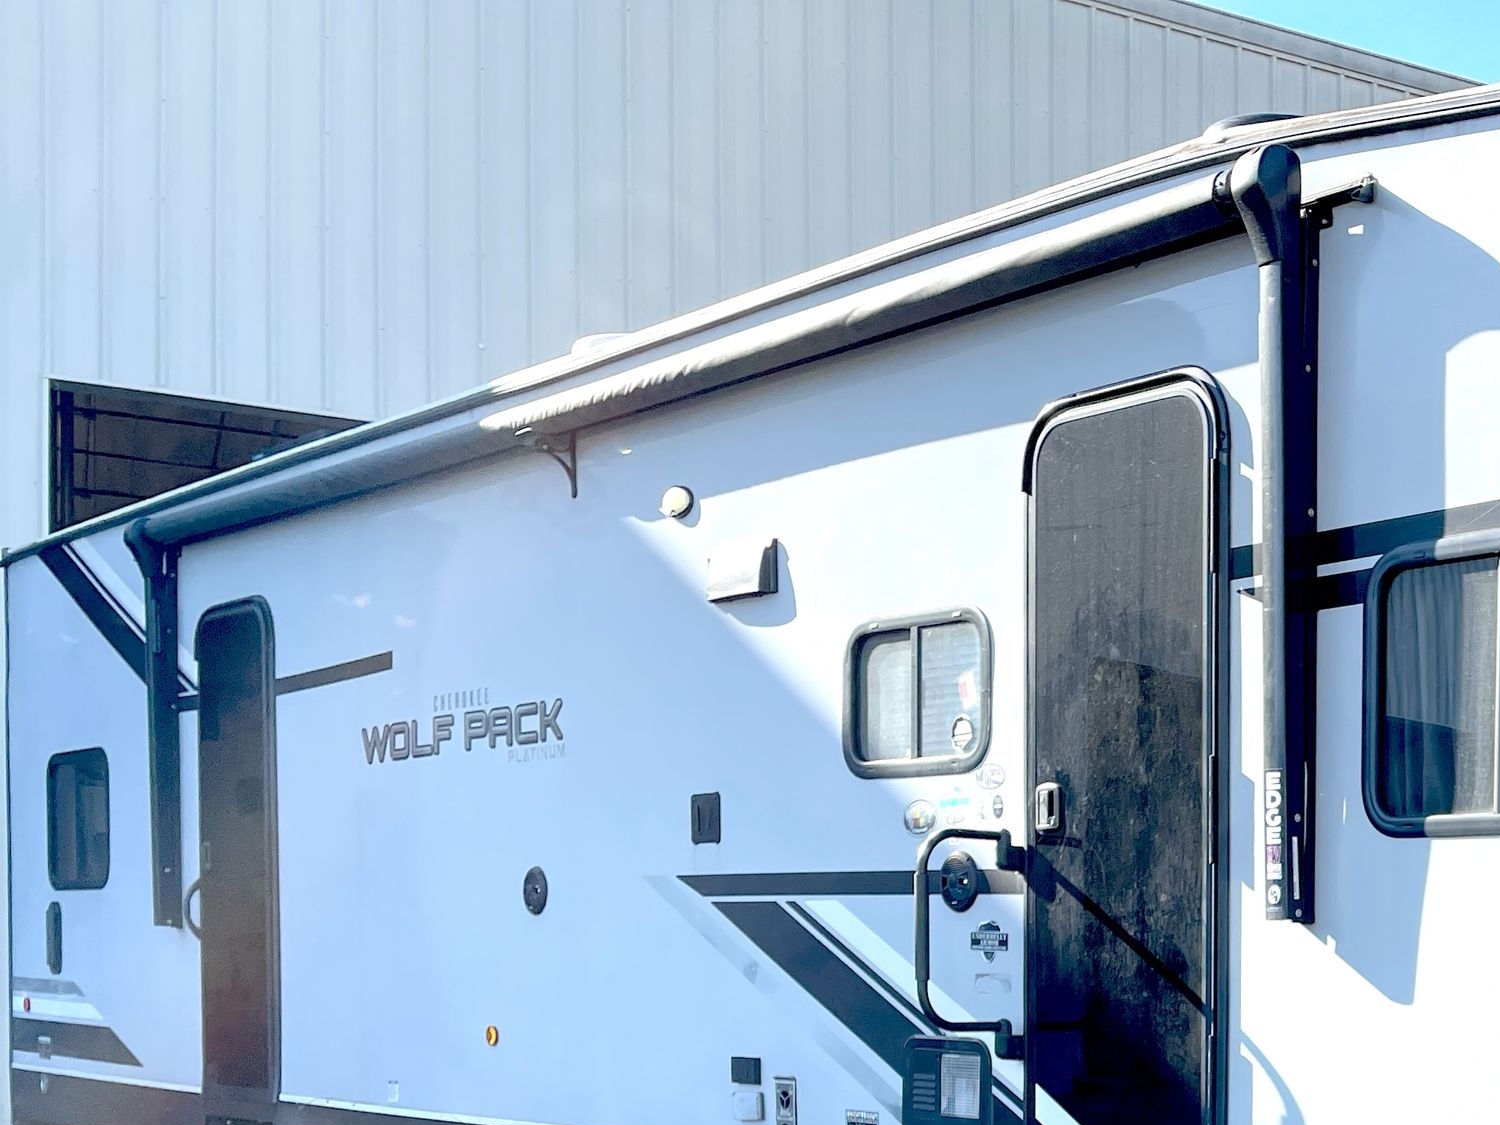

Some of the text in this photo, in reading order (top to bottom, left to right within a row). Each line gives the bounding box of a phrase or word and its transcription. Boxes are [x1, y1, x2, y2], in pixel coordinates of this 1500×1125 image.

[361, 697, 564, 765] WOLF PACK
[508, 743, 566, 765] PLATINUM
[1265, 771, 1282, 845] EDGE
